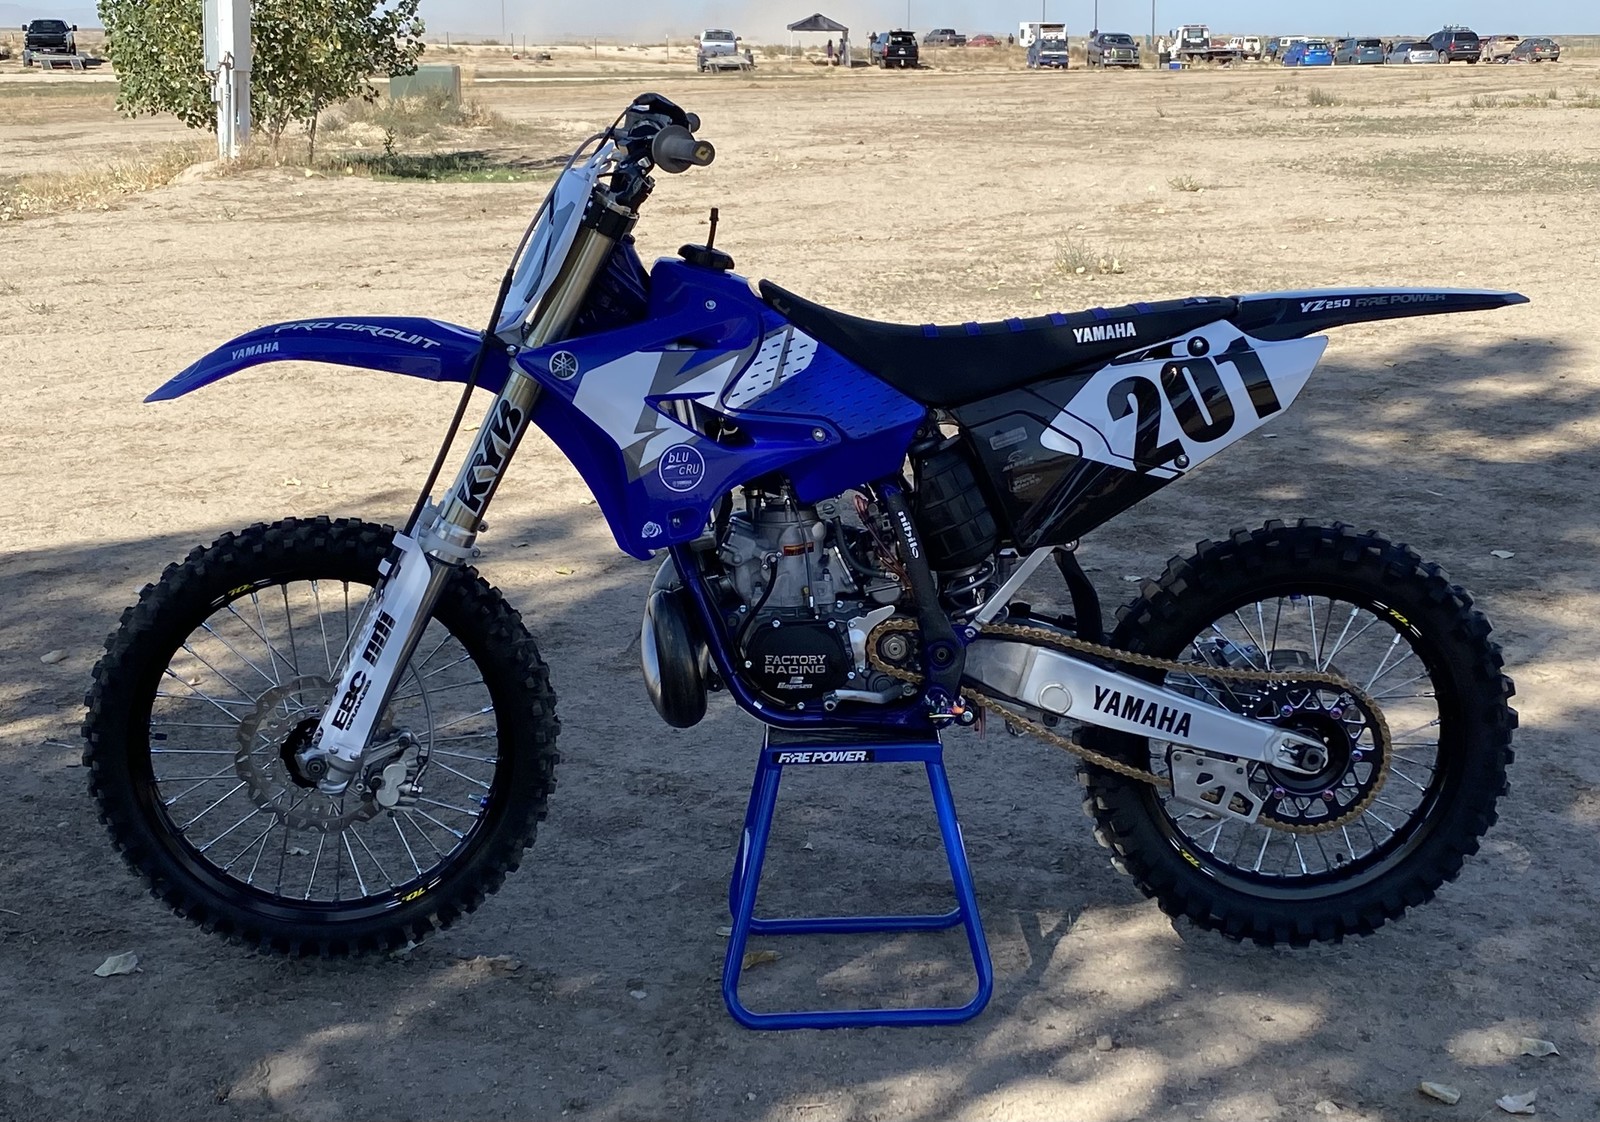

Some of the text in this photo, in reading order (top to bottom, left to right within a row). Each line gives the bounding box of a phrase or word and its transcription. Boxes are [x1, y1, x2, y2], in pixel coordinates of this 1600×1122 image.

[1300, 298, 1351, 313] YZ250
[274, 322, 440, 349] PRO CIRCUIT
[1072, 322, 1137, 344] YAMAHA
[231, 341, 279, 361] YAMAHA
[1106, 336, 1282, 472] 201
[456, 399, 523, 516] KYB
[898, 511, 919, 558] nihilo
[765, 654, 826, 665] FACTORY
[765, 665, 826, 674] RACING
[331, 670, 366, 731] EBC
[1093, 684, 1192, 738] YAMAHA
[778, 751, 867, 763] FIRE POWER
